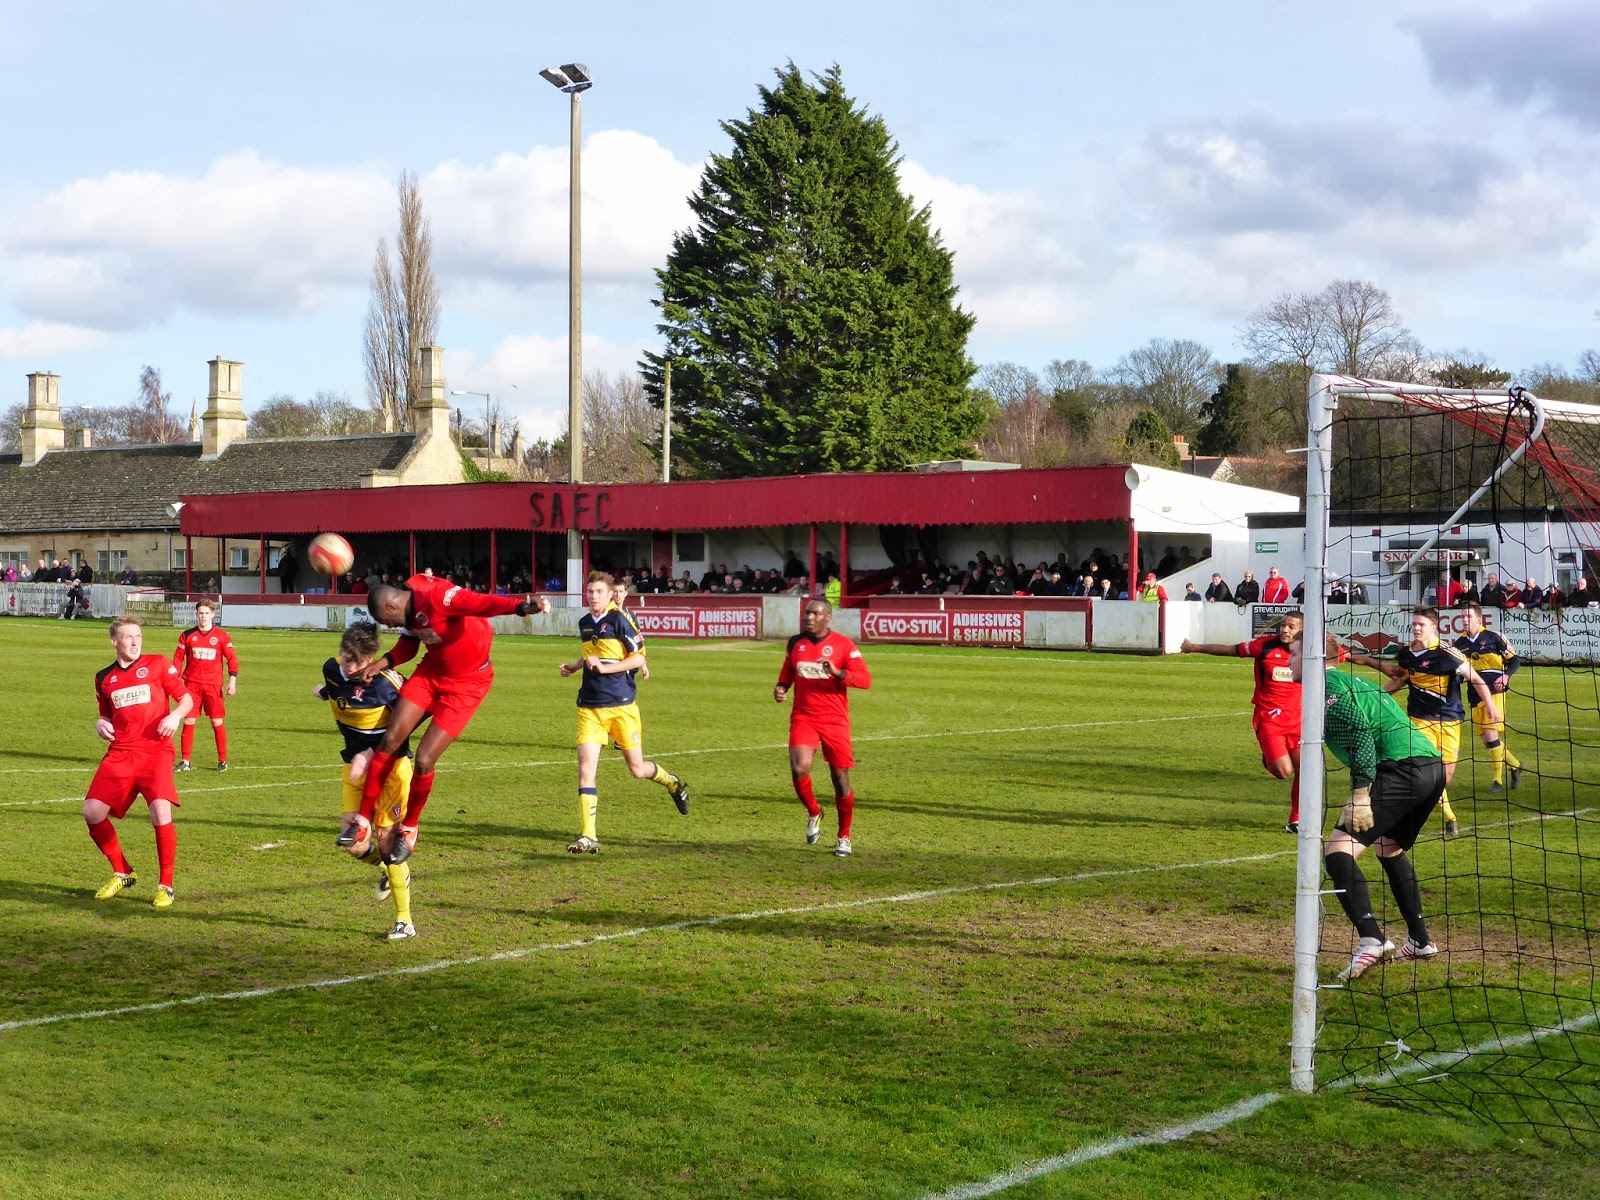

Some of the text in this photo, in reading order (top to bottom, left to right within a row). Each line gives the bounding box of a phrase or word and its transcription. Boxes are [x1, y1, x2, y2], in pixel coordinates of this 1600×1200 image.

[529, 492, 609, 529] SAFC
[1438, 552, 1463, 560] BAR
[699, 610, 756, 624] ADHESIVES
[953, 613, 1022, 627] ADHESIVES
[1326, 606, 1413, 633] utland Coun
[1543, 614, 1569, 622] MN
[699, 625, 756, 637] & SEALANTS
[1437, 614, 1493, 635] GOF
[953, 628, 1022, 642] & SEALANTS
[1508, 638, 1531, 646] RIVING
